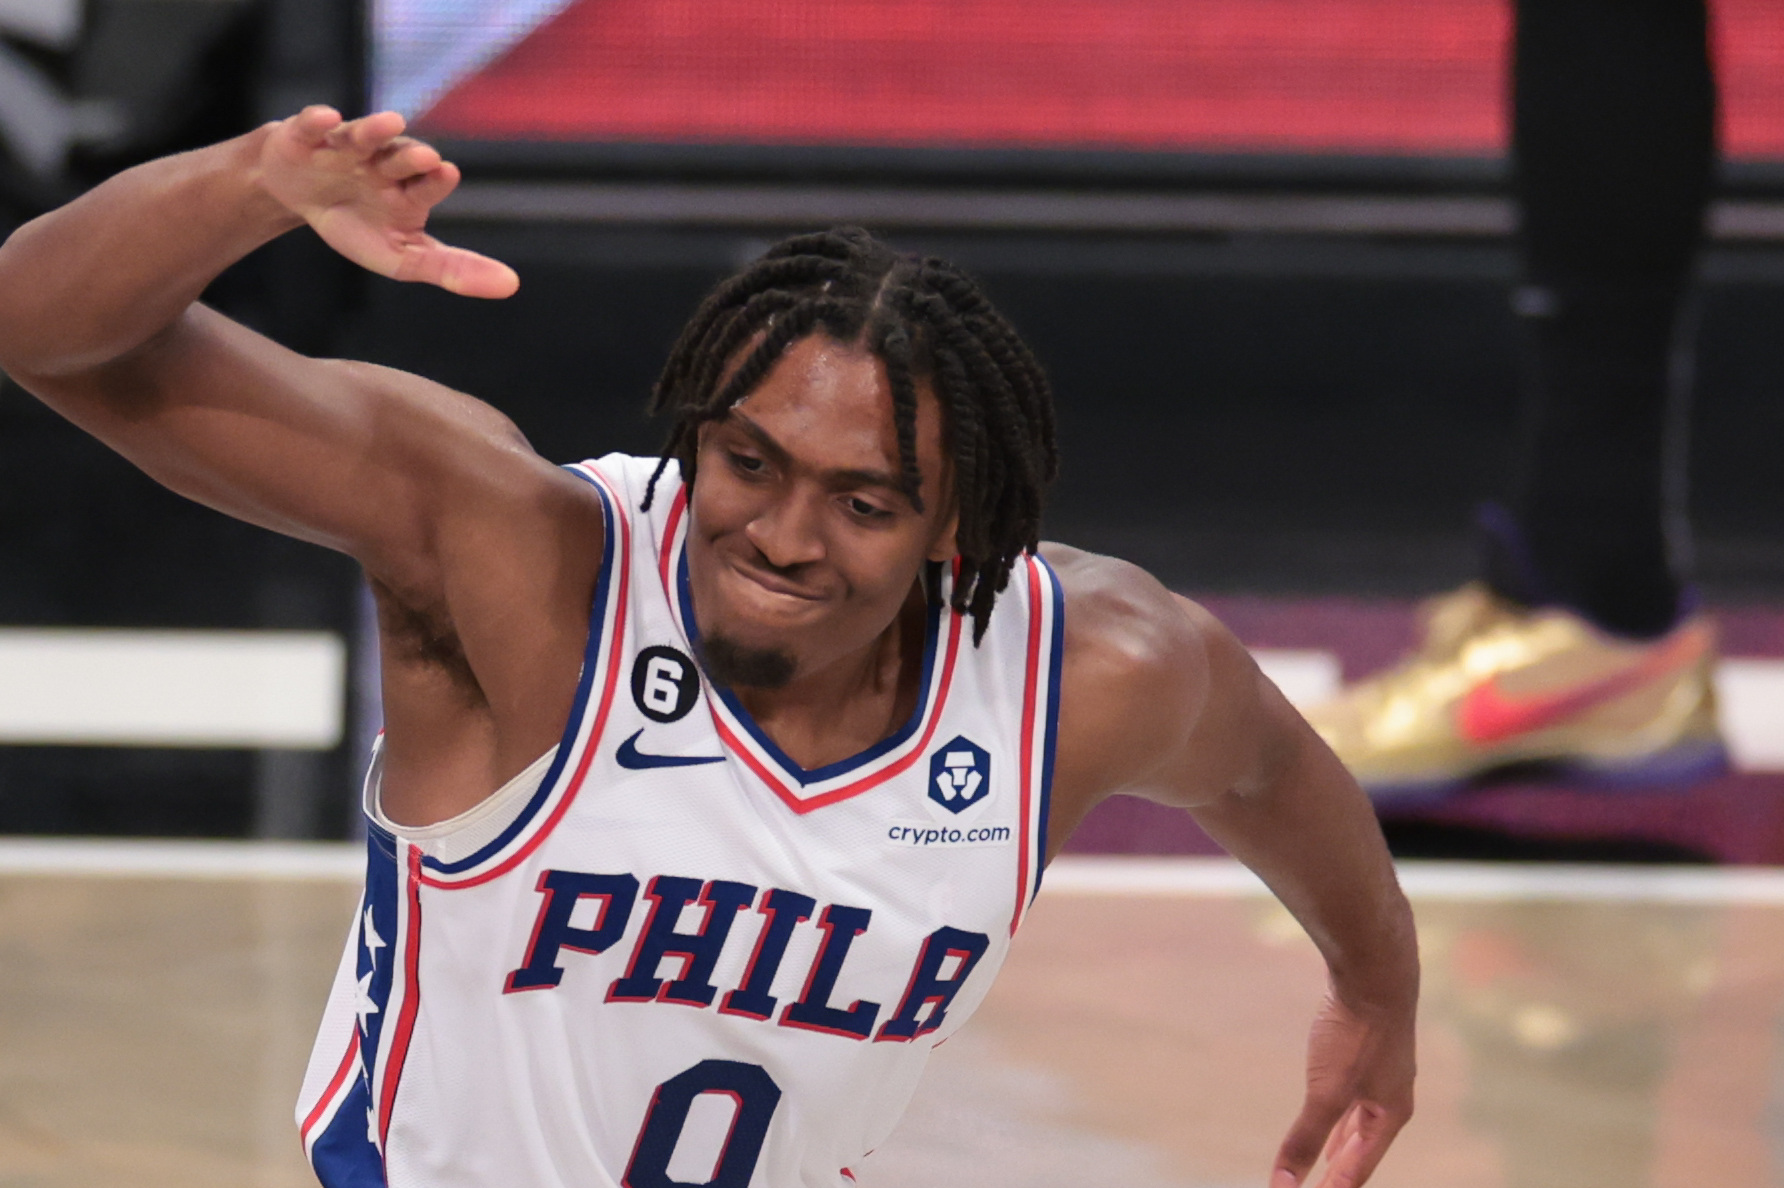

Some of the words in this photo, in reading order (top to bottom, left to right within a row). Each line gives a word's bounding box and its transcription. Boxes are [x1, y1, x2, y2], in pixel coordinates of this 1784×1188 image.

[642, 654, 684, 715] 6
[887, 826, 1011, 846] crypto.com
[502, 868, 991, 1043] PHILA
